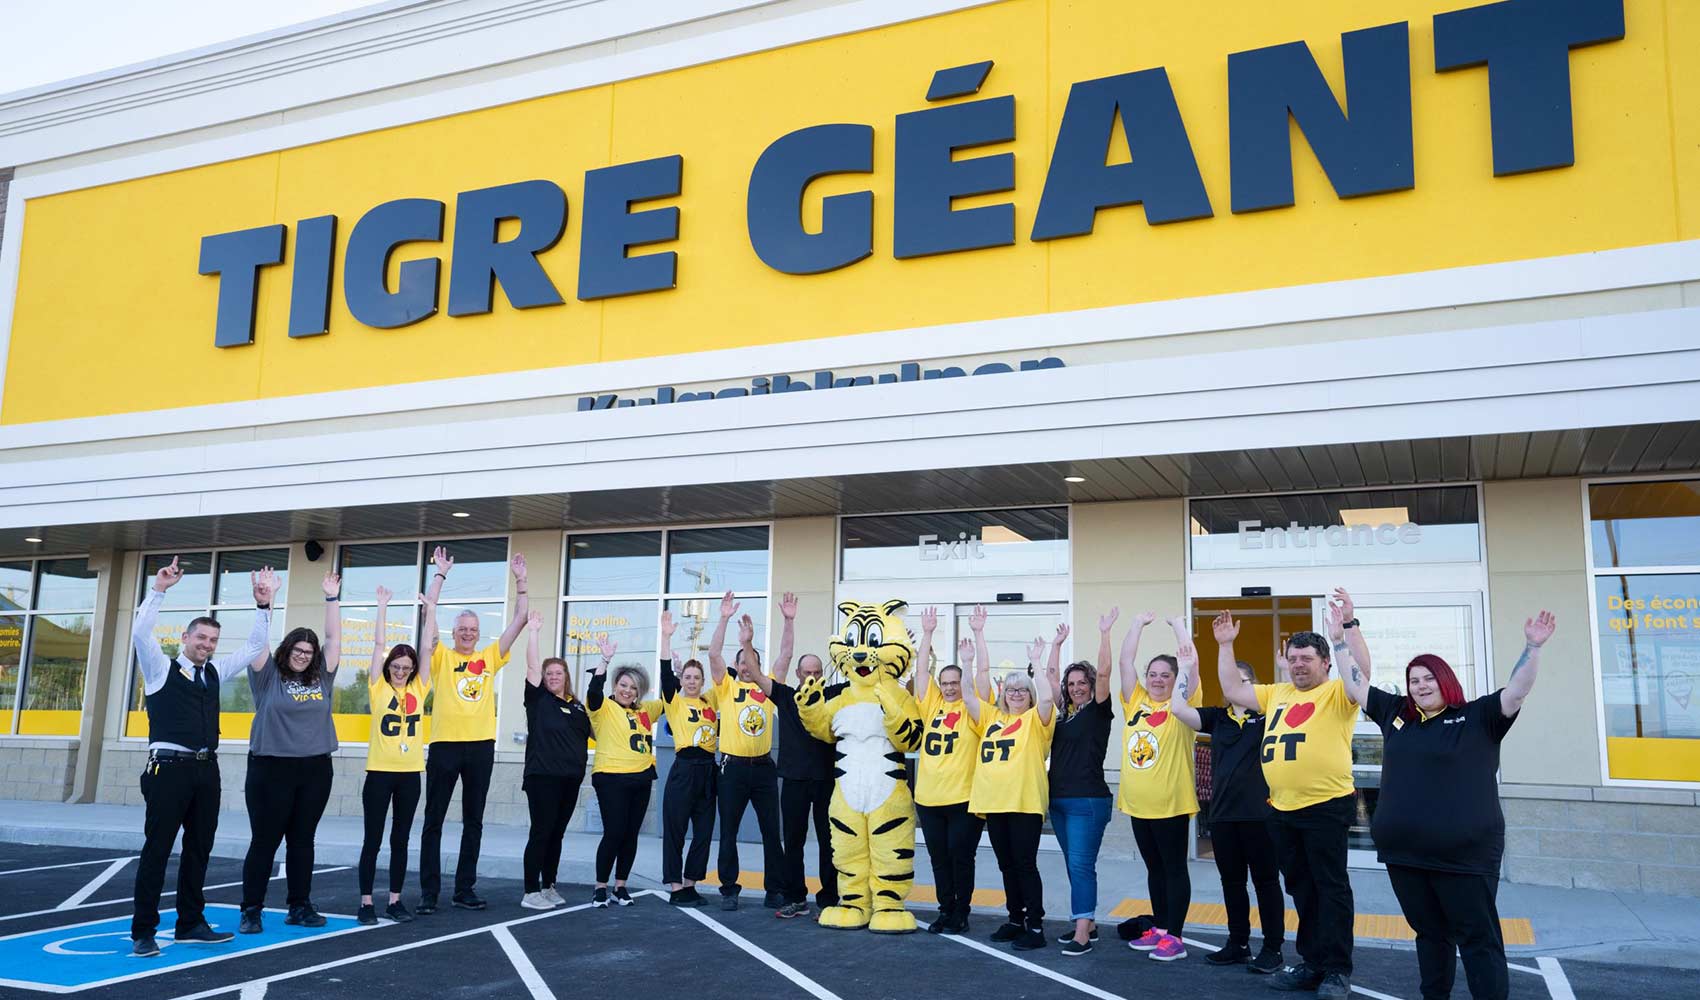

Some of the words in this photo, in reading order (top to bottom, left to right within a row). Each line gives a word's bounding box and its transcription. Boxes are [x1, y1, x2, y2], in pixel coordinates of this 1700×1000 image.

[199, 154, 683, 348] TIGRE
[747, 0, 1626, 276] GÉANT
[919, 532, 985, 561] Exit
[1238, 520, 1424, 550] Entrance
[1608, 595, 1645, 610] Des
[1650, 594, 1700, 610] écon
[571, 616, 590, 628] Buy
[592, 615, 630, 626] online.
[1609, 613, 1639, 632] qui
[1644, 613, 1688, 629] font
[569, 630, 592, 640] Pick
[381, 714, 420, 737] GT
[925, 731, 959, 756] GT
[981, 739, 1015, 764] GT
[1261, 732, 1306, 764] GT
